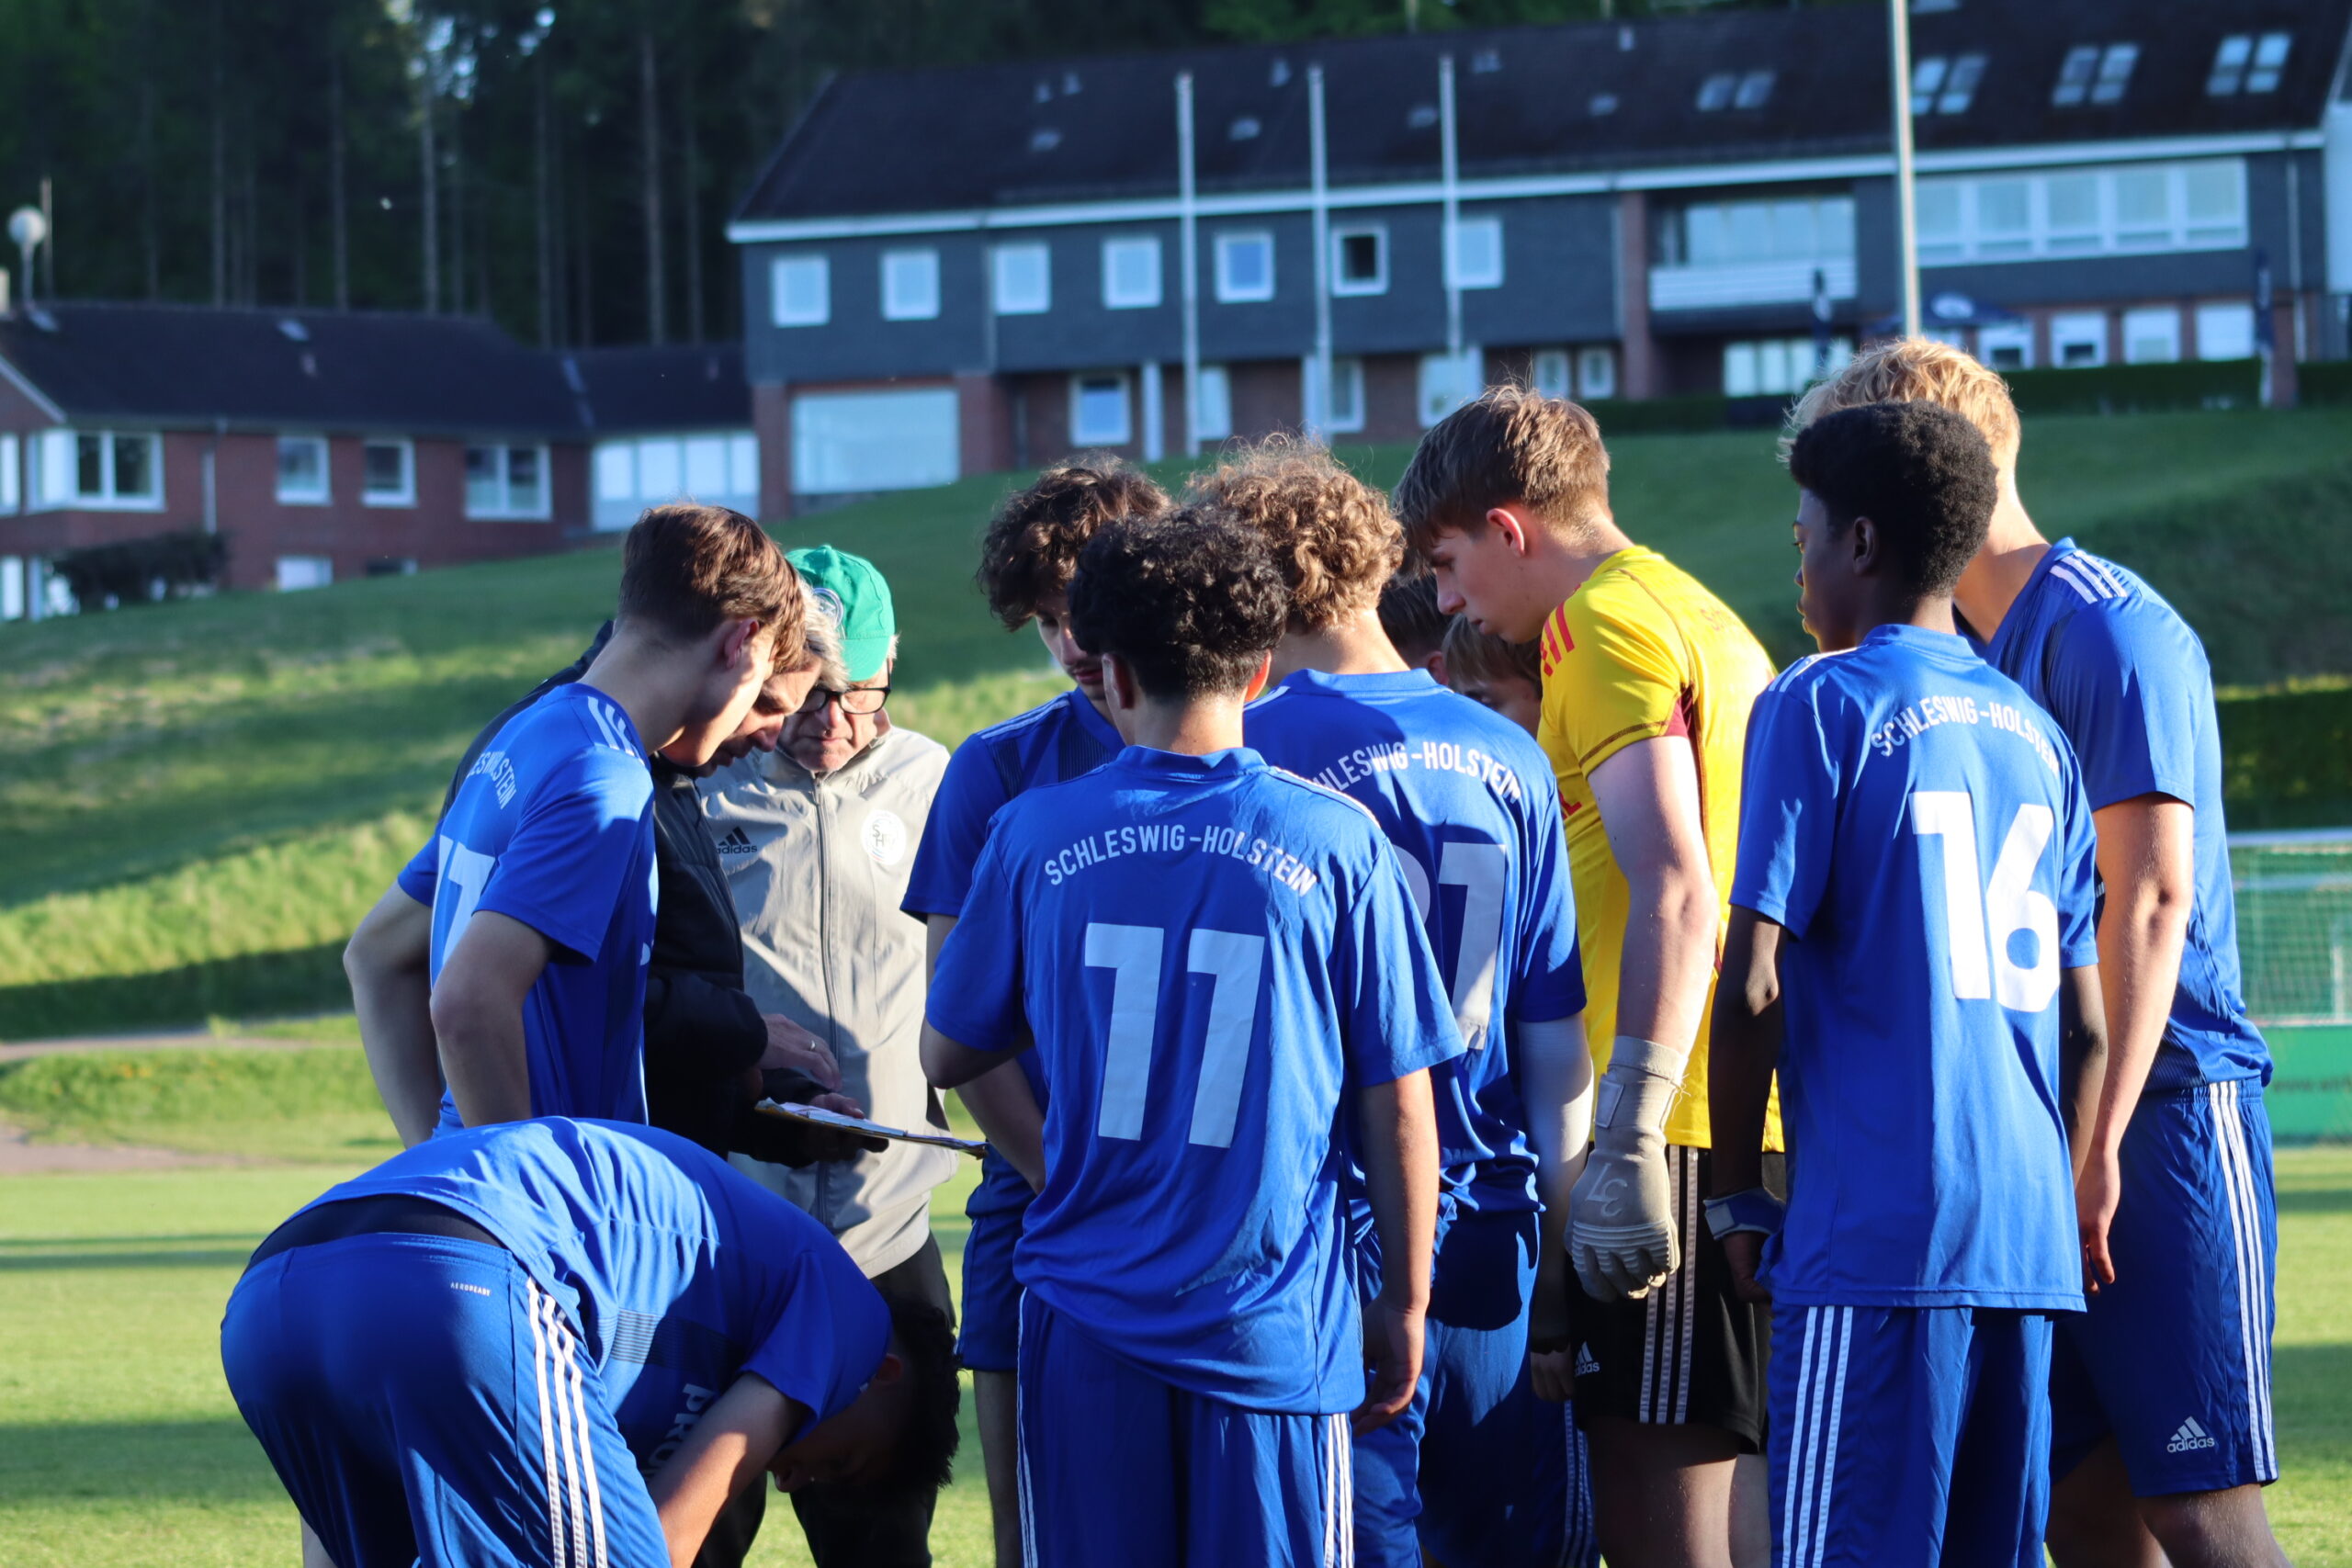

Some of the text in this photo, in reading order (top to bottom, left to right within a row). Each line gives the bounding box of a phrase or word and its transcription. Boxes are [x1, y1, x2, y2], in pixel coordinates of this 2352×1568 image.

[1312, 741, 1521, 805] HLESWIG-HOLSTEIN
[1044, 825, 1317, 897] SCHLESWIG-HOLSTEIN
[1908, 791, 2061, 1013] 16
[1391, 842, 1507, 1050] 1
[1084, 922, 1264, 1148] 11
[646, 1383, 715, 1475] PRO
[2167, 1437, 2215, 1453] adidas
